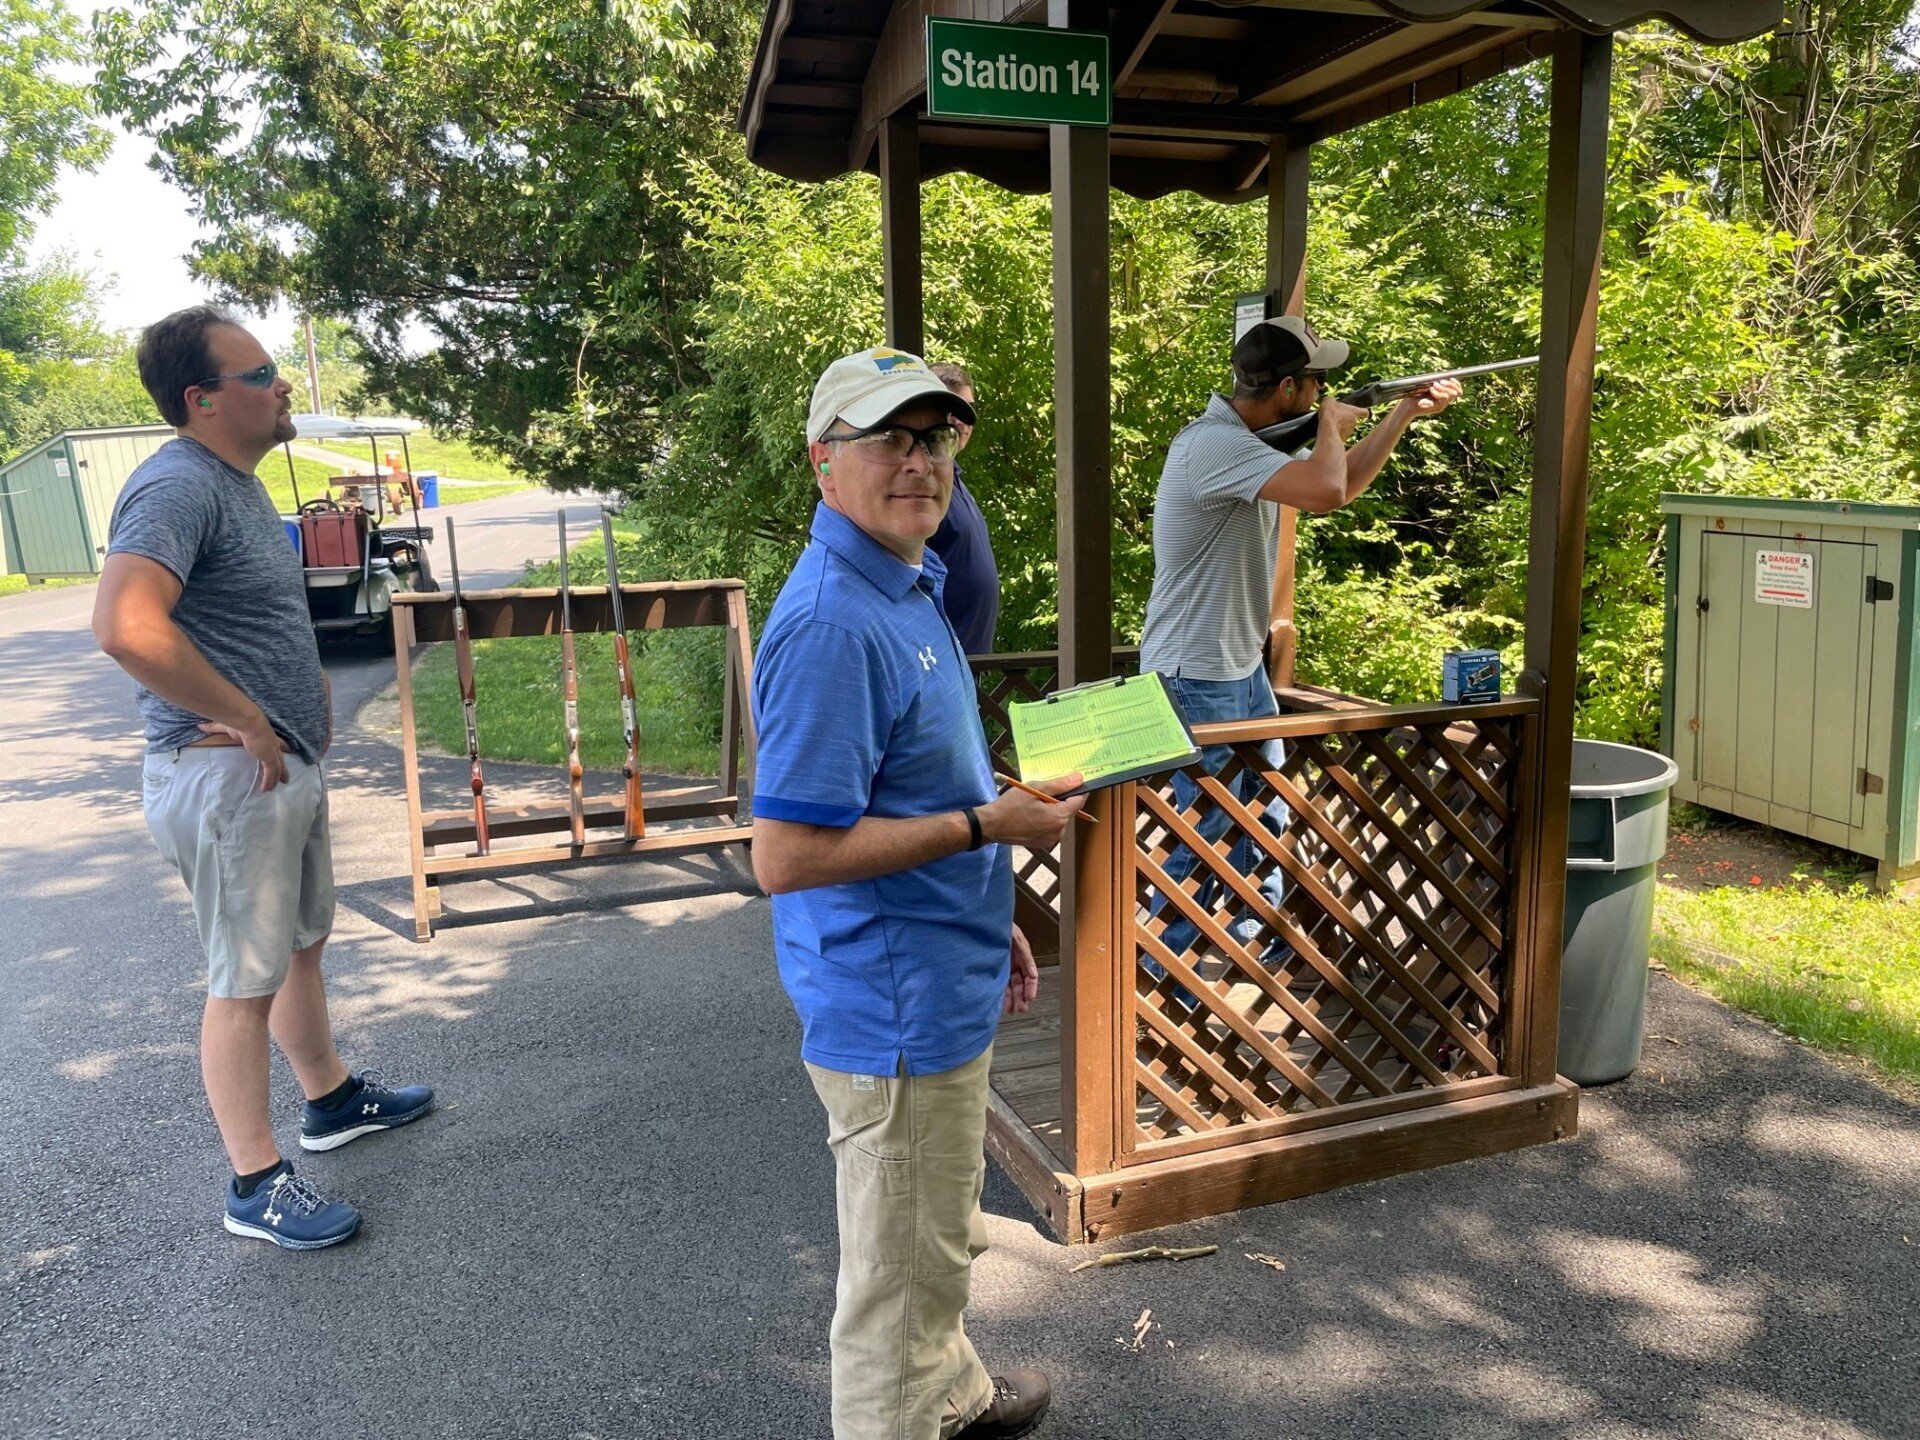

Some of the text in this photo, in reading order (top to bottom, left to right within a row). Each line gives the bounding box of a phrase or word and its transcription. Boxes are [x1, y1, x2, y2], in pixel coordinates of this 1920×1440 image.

[941, 48, 1100, 96] Station 14
[1768, 555, 1800, 564] DANGER
